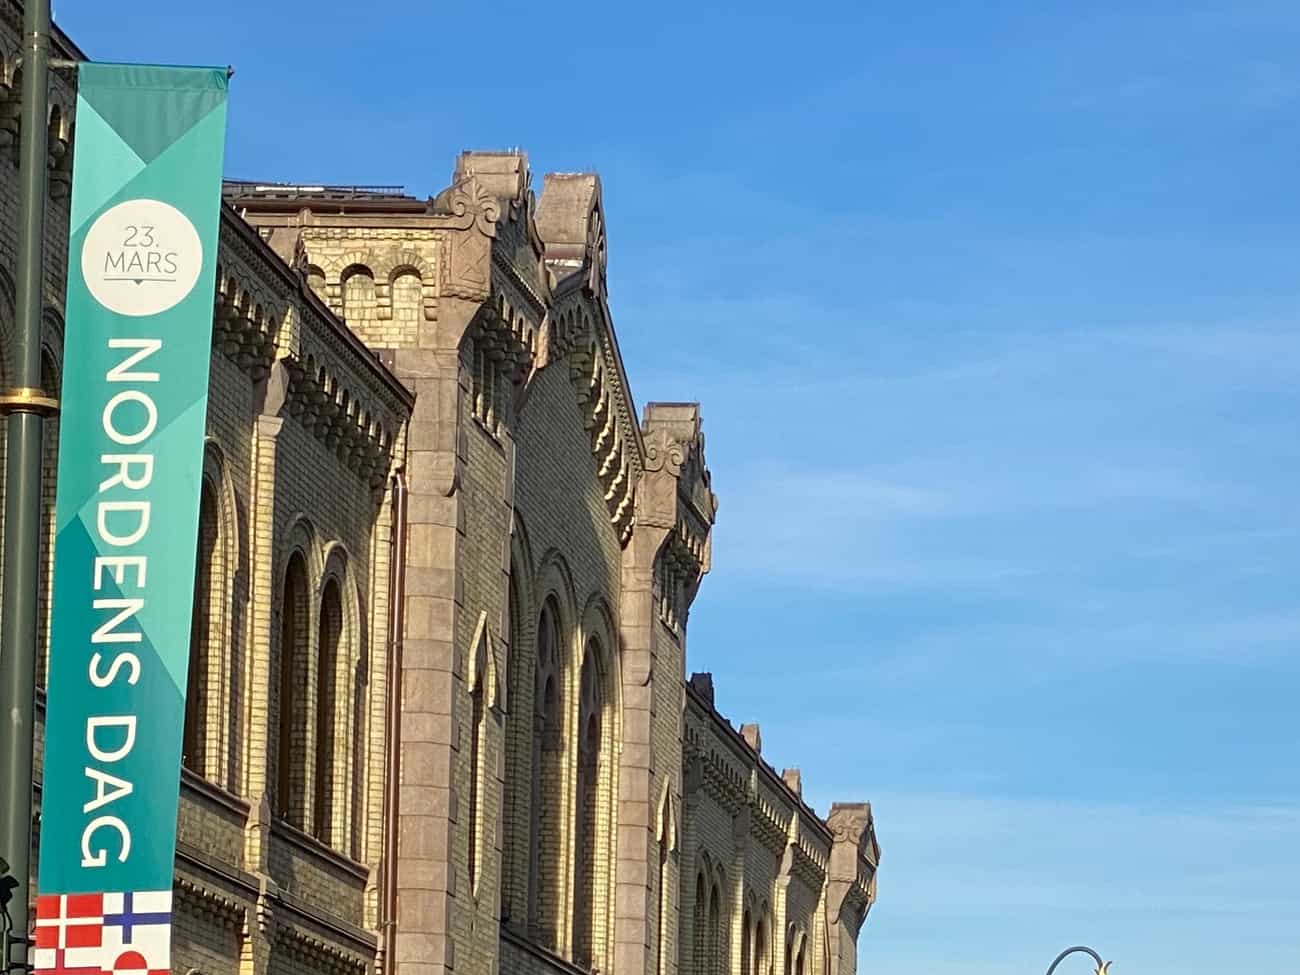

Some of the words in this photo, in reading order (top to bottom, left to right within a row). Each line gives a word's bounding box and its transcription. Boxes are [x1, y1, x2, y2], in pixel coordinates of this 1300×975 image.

[103, 251, 179, 275] MARS
[123, 225, 161, 248] 23.
[90, 338, 163, 688] NORDENS
[80, 714, 137, 868] DAG
